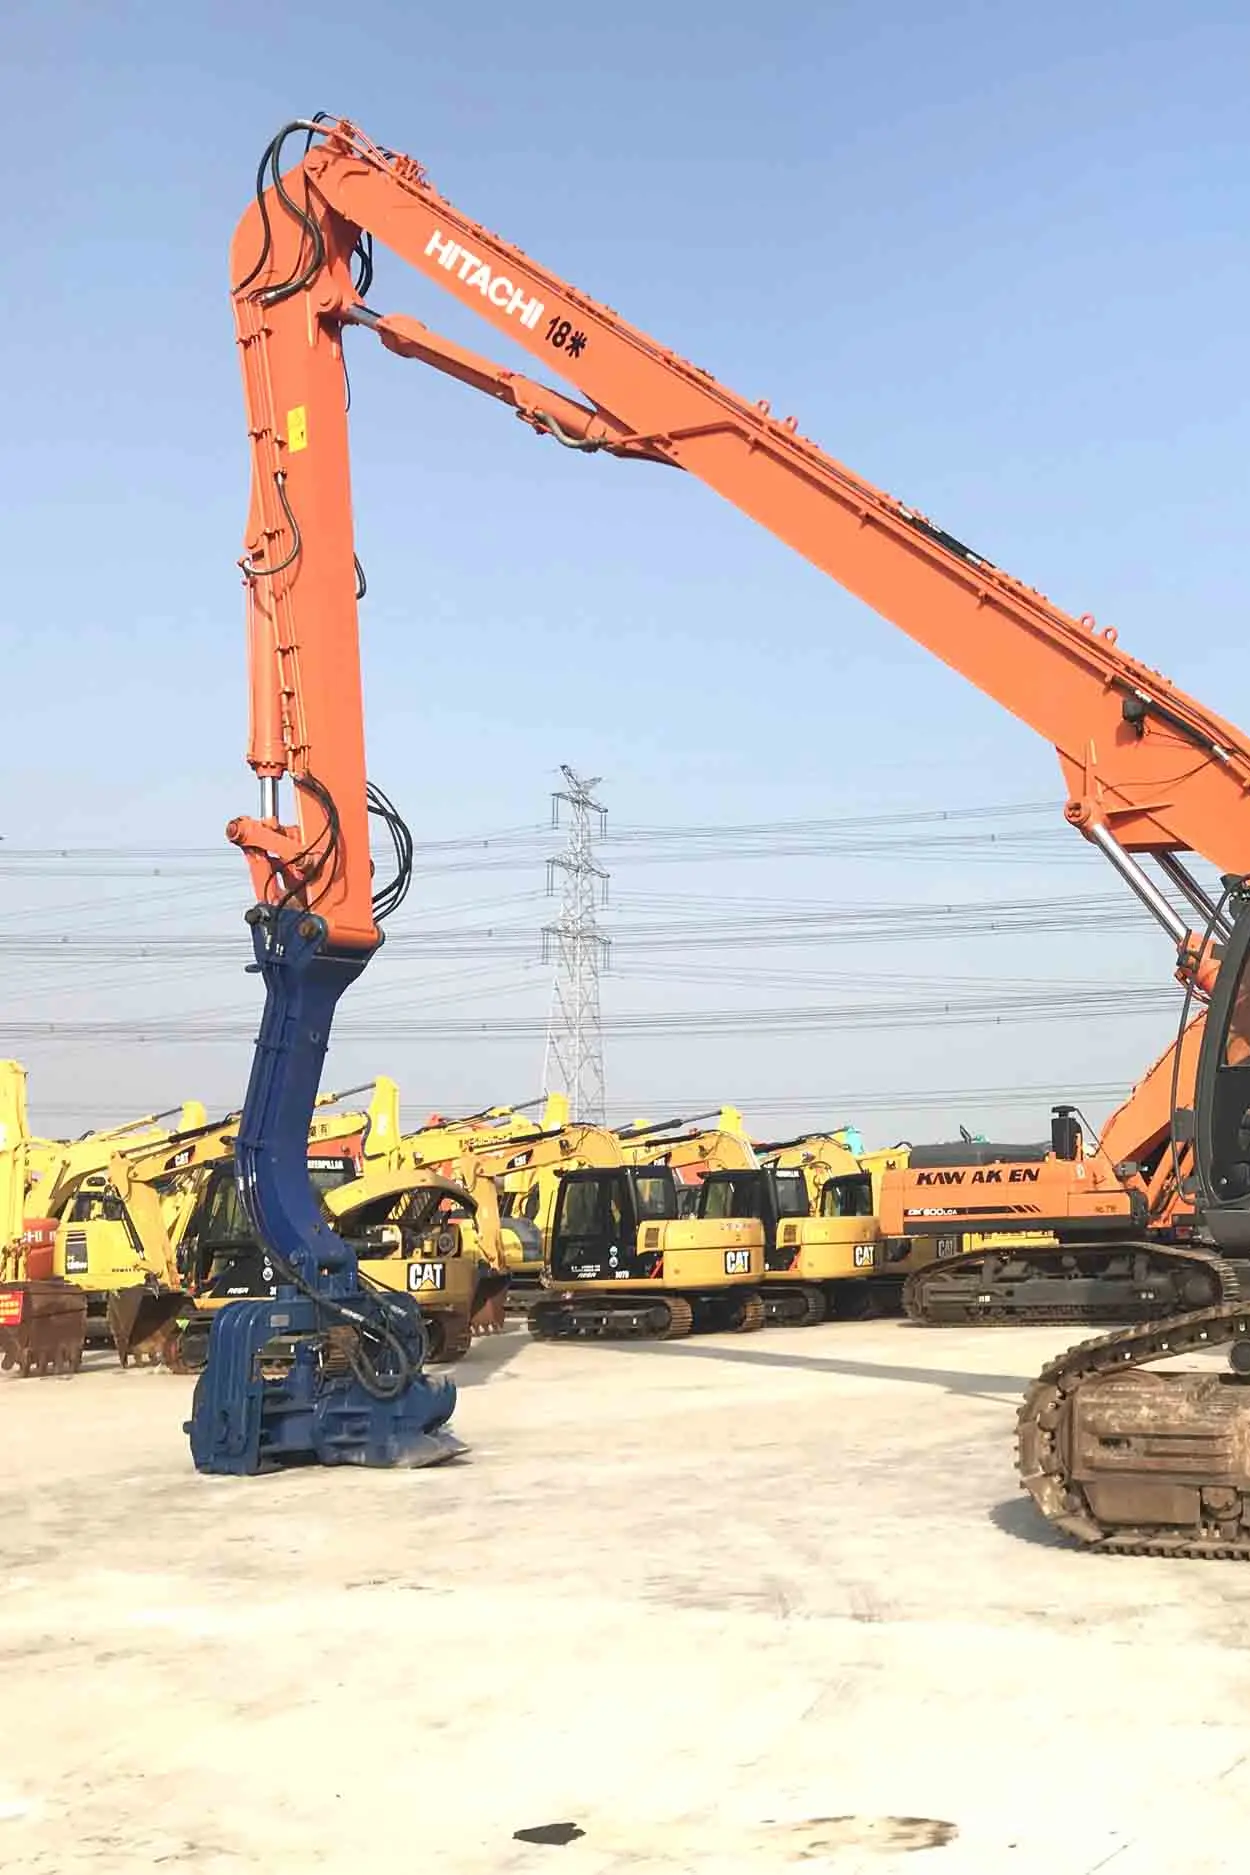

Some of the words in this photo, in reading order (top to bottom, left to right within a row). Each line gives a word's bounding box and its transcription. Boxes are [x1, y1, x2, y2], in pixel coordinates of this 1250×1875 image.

[424, 229, 545, 329] HITACHI
[174, 1151, 189, 1167] CAT
[854, 1245, 875, 1266] CAT
[938, 1239, 953, 1258] CAT
[725, 1251, 750, 1274] CAT
[409, 1263, 444, 1290] CAT
